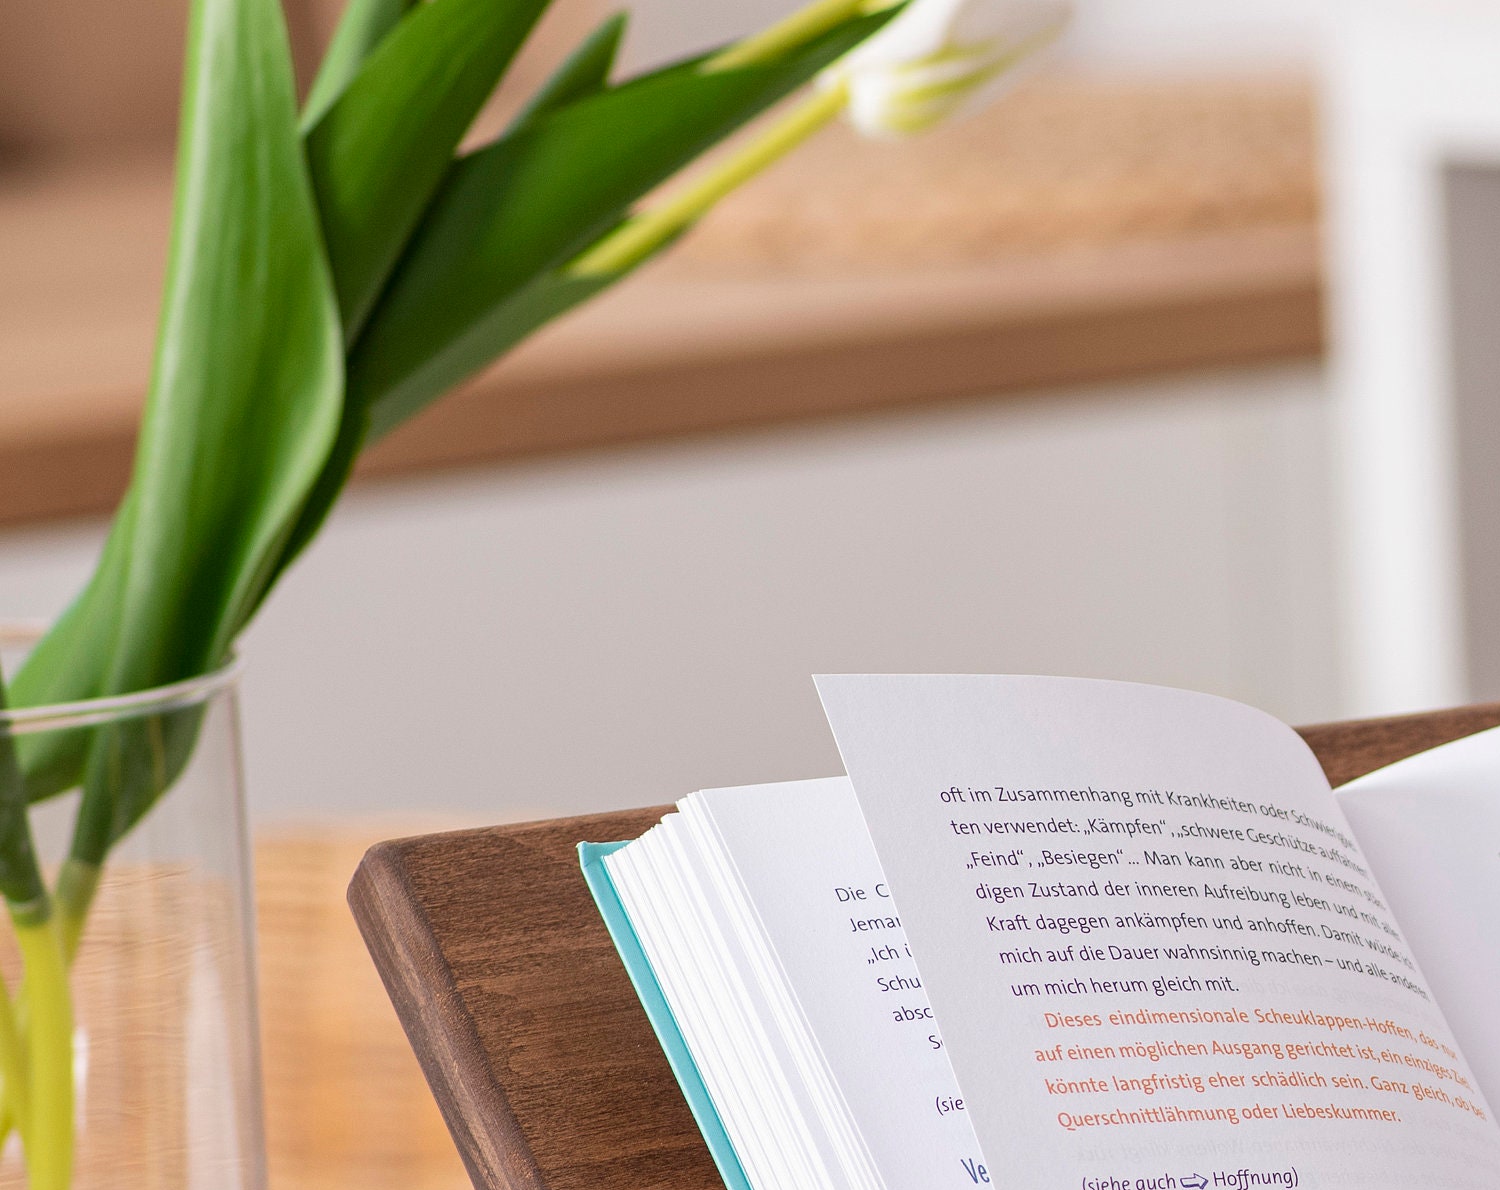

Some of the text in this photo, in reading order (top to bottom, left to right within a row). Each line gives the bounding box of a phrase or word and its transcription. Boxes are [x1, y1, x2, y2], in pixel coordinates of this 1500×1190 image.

[940, 787, 966, 803] oft
[968, 787, 992, 802] im
[994, 786, 1133, 807] Zusammenhang
[1135, 790, 1164, 804] mit
[1165, 791, 1257, 814] Krankheiten
[1259, 803, 1290, 820] oder
[835, 887, 867, 902] Die
[868, 945, 899, 964] „Ich
[1011, 976, 1239, 996] um mich herum gleich mit.
[1058, 1103, 1401, 1131] Querschnittlähmung oder Liebeskummer.
[1136, 1173, 1176, 1190] auch
[1213, 1166, 1298, 1190] Hoffnung)
